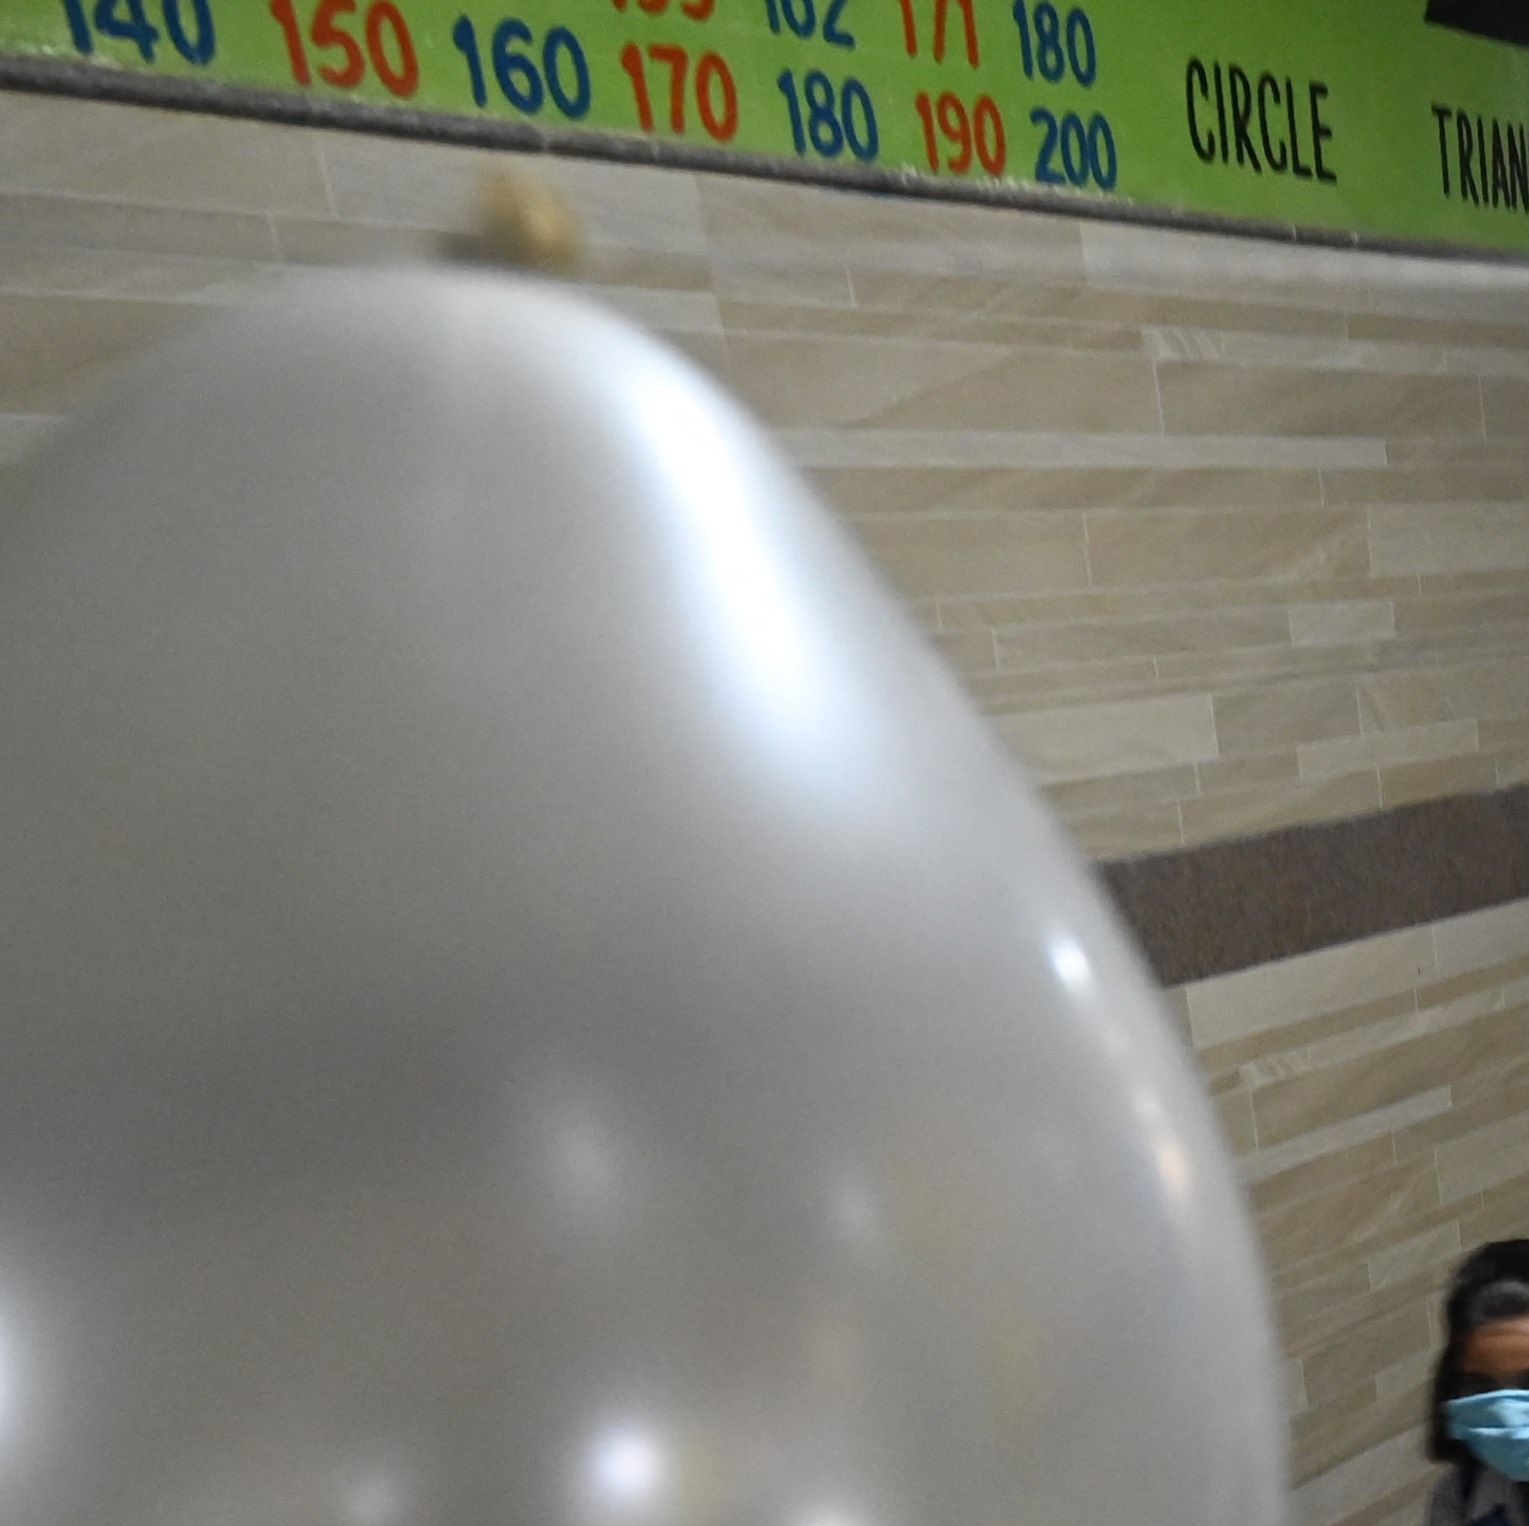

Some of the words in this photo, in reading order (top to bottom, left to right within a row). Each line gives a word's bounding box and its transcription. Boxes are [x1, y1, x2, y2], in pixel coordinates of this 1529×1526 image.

[270, 0, 419, 99] 150
[452, 15, 591, 120] 160
[620, 40, 738, 143] 170
[778, 67, 880, 162] 180
[914, 90, 1006, 178] 190
[1030, 106, 1118, 191] 200
[1012, 0, 1097, 87] 180
[1186, 57, 1337, 185] CIRCLE
